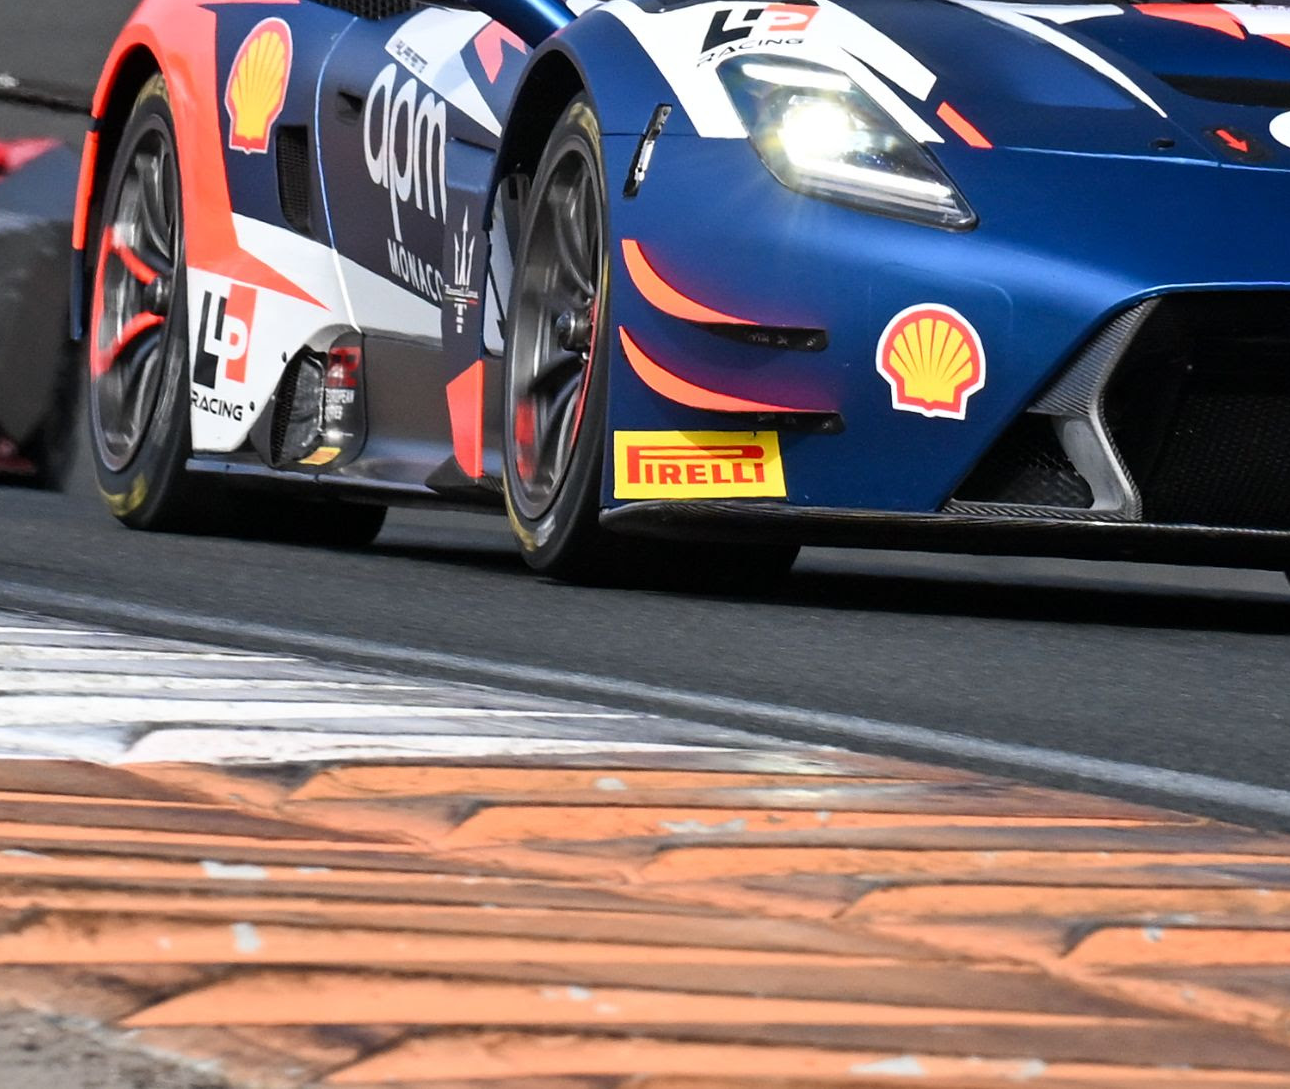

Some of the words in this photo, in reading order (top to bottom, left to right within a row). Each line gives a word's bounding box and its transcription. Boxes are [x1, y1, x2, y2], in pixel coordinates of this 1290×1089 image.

[696, 38, 804, 68] RACING
[364, 62, 447, 243] apm
[627, 445, 765, 485] PIRELLI
